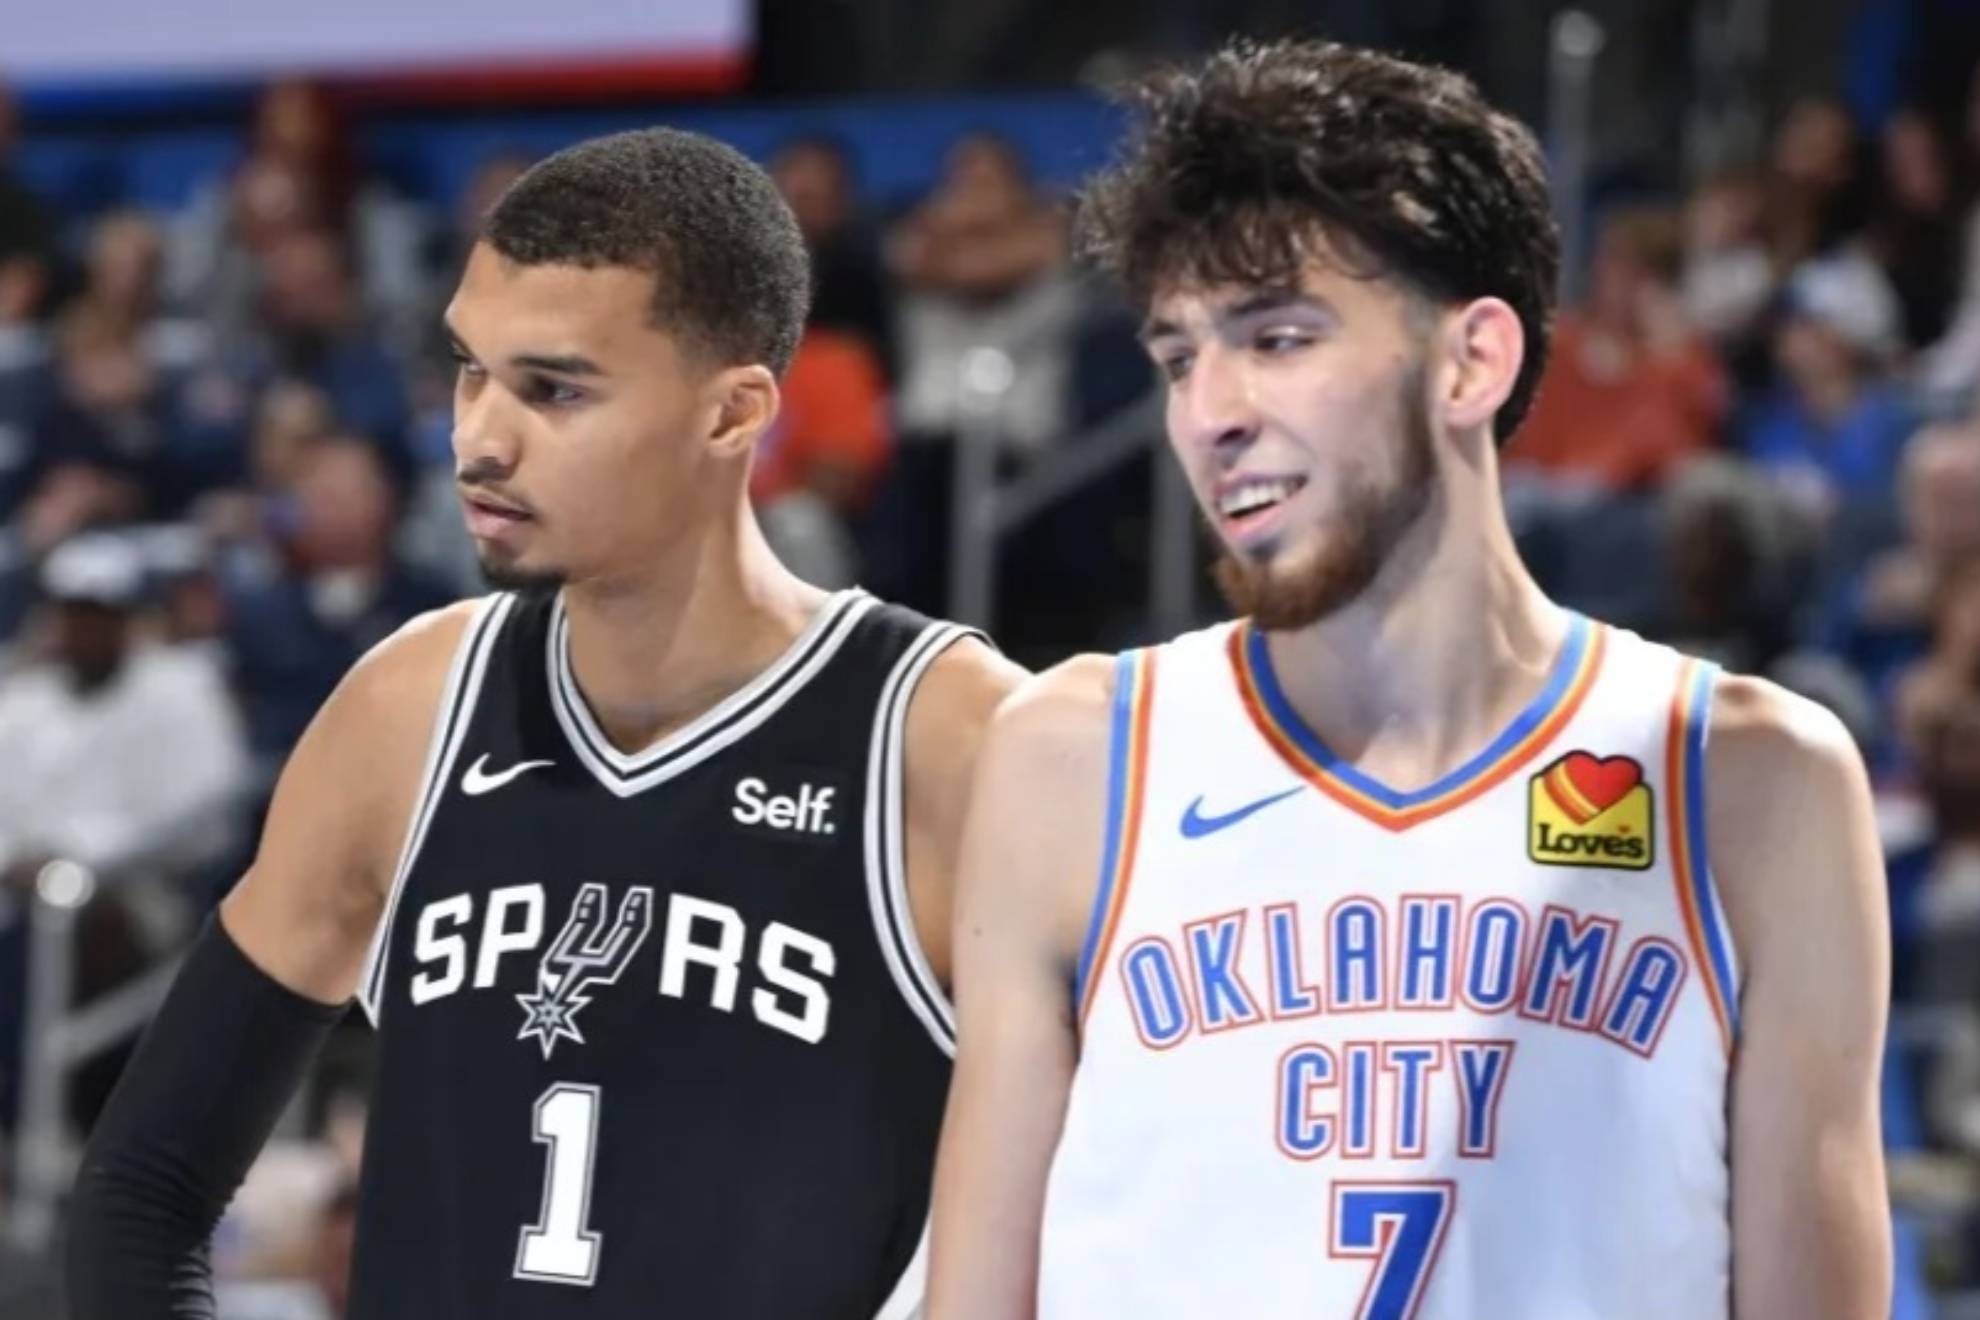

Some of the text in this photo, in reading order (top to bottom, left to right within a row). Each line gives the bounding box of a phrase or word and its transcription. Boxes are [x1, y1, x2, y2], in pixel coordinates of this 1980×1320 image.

[732, 777, 835, 834] Self.
[410, 882, 836, 1060] SPURS
[1120, 896, 1687, 1058] OKLAHOMA
[1276, 1041, 1516, 1160] CITY
[513, 1081, 602, 1286] 1
[1328, 1180, 1456, 1320] 7
